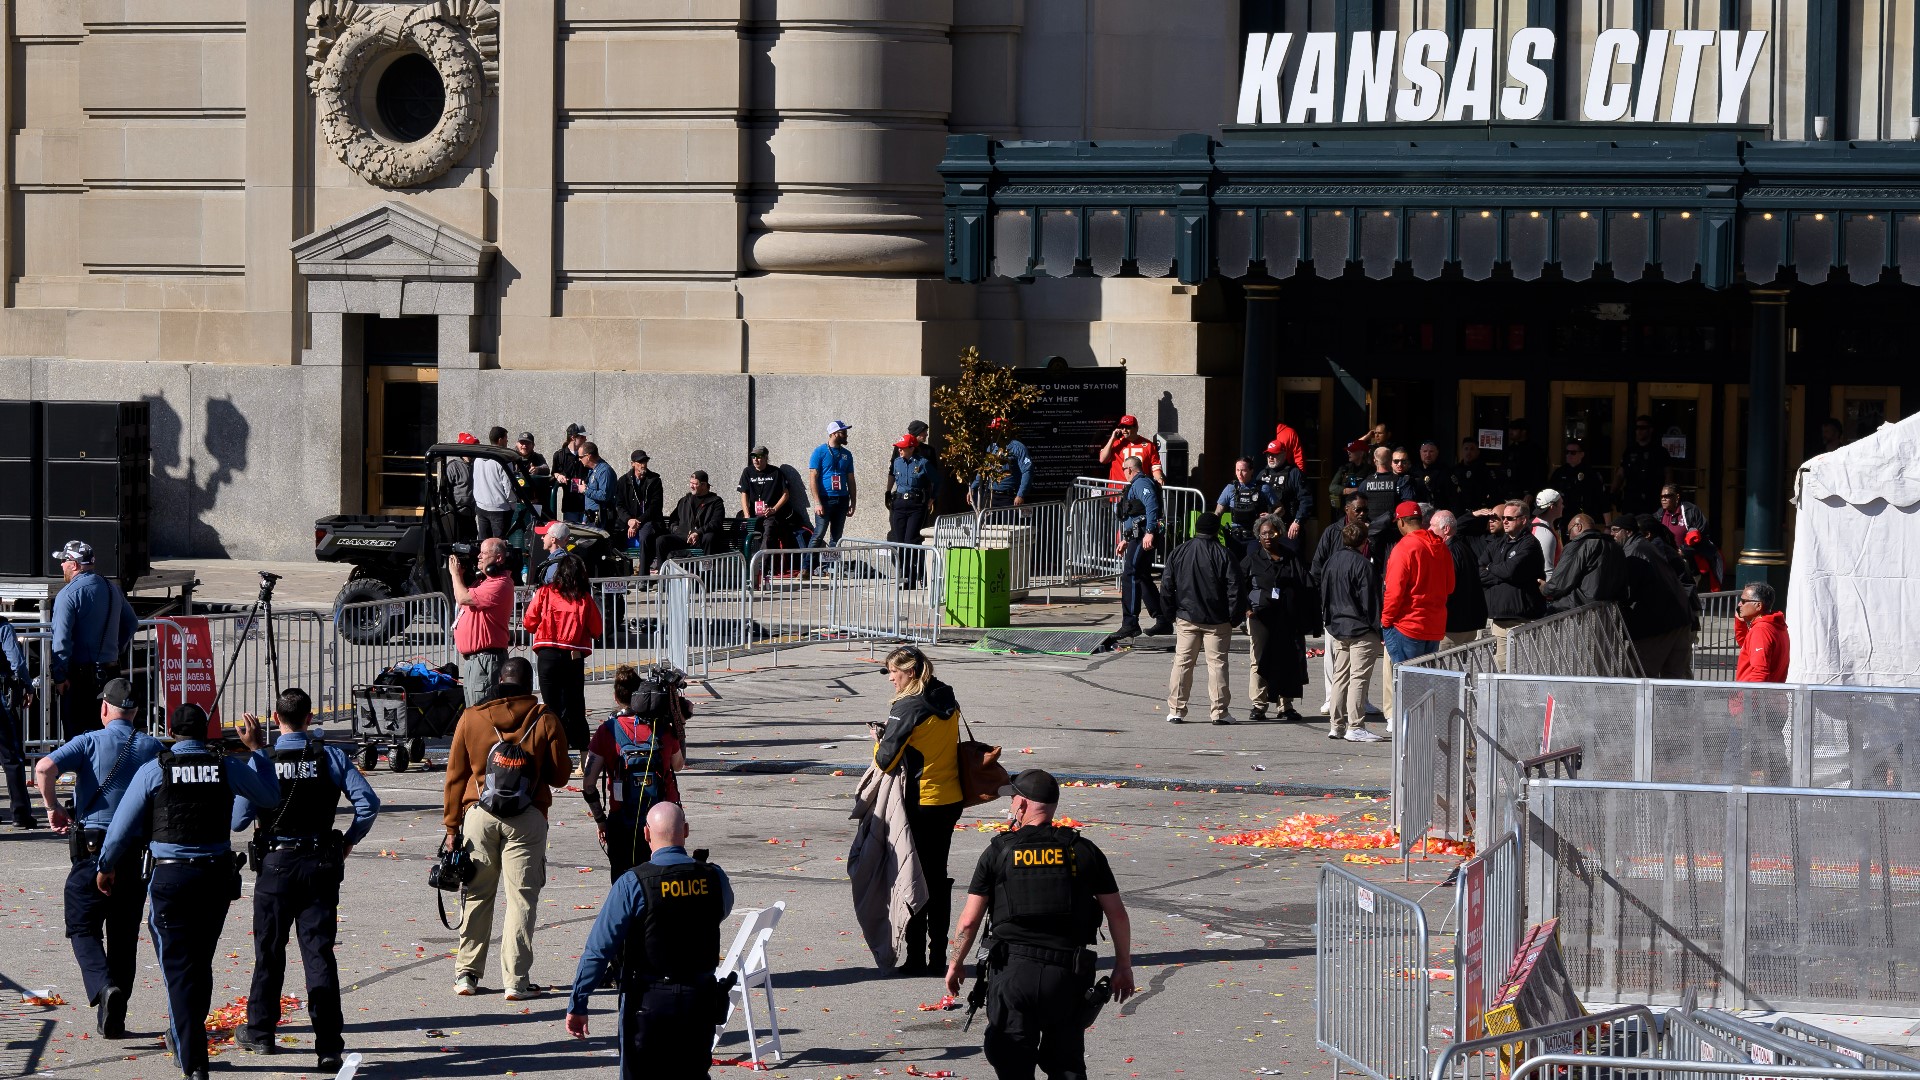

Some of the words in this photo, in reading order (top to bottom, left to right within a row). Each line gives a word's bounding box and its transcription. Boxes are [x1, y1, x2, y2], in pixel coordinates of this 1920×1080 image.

[1236, 27, 1556, 124] KANSAS
[1583, 27, 1769, 123] CITY
[206, 658, 213, 669] 3
[166, 672, 205, 681] BEVEAGES
[206, 672, 212, 681] &
[169, 683, 211, 692] BATROOMS
[172, 765, 220, 783] POLICE
[274, 760, 318, 780] POLICE
[1014, 848, 1064, 866] POLICE
[661, 878, 709, 898] POLICE
